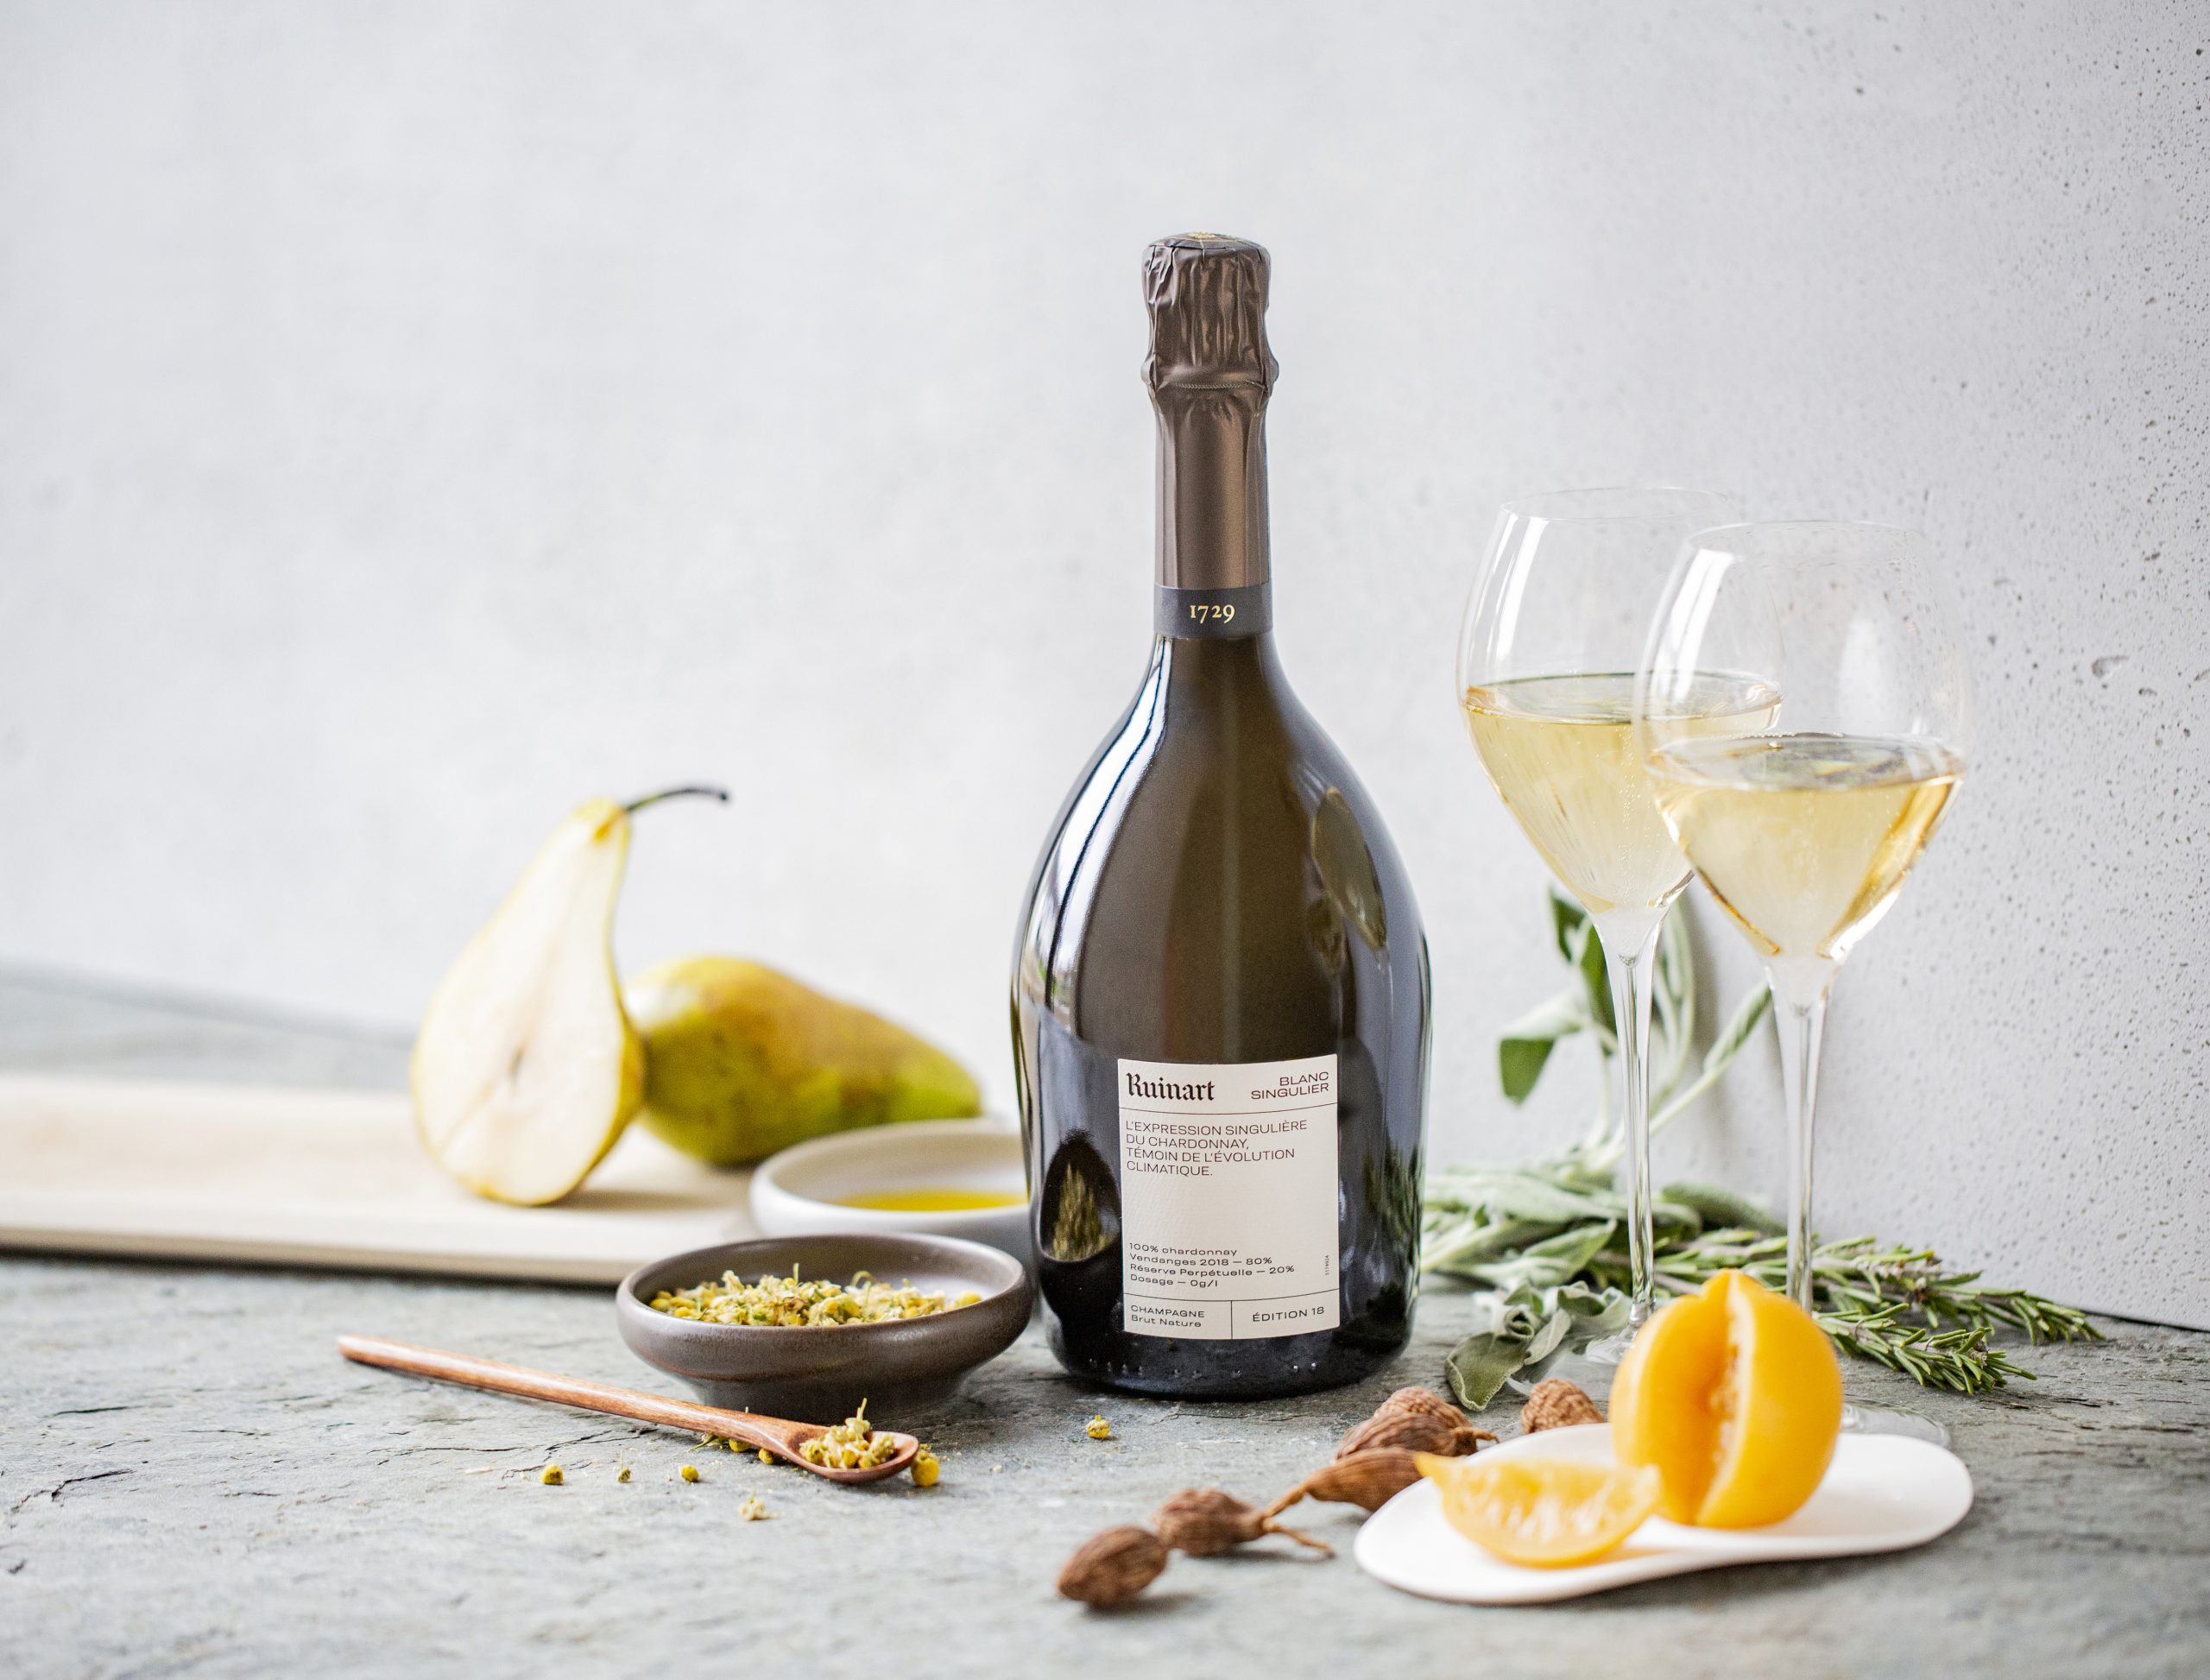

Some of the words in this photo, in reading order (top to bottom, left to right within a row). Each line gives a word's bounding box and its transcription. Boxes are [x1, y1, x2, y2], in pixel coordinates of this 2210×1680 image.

[1190, 604, 1235, 623] 1729
[1126, 1072, 1216, 1101] Ruinart
[1279, 1071, 1329, 1087] BLANC
[1251, 1083, 1329, 1100] SINGULIER
[1225, 1120, 1308, 1135] SINGULIÈRE
[1126, 1134, 1145, 1146] DU
[1148, 1136, 1249, 1150] CHARDONNAY,
[1127, 1146, 1178, 1161] TÉMOIN
[1182, 1153, 1200, 1162] DE
[1127, 1160, 1213, 1177] CLIMATIQUE.
[1130, 1243, 1159, 1253] 100%
[1162, 1247, 1237, 1256] chardonnay
[1130, 1253, 1197, 1266] Vendanges
[1246, 1257, 1272, 1266] 80%
[1130, 1263, 1176, 1274] Réserve
[1180, 1268, 1253, 1277] Perpétuelle
[1269, 1266, 1295, 1274] 20%
[1130, 1273, 1173, 1286] Dosage
[1131, 1304, 1205, 1318] CHAMPAGNE
[1253, 1309, 1308, 1323] ÉDITION
[1311, 1306, 1324, 1316] 18
[1131, 1315, 1156, 1324] Brut
[1159, 1318, 1202, 1328] Nature
